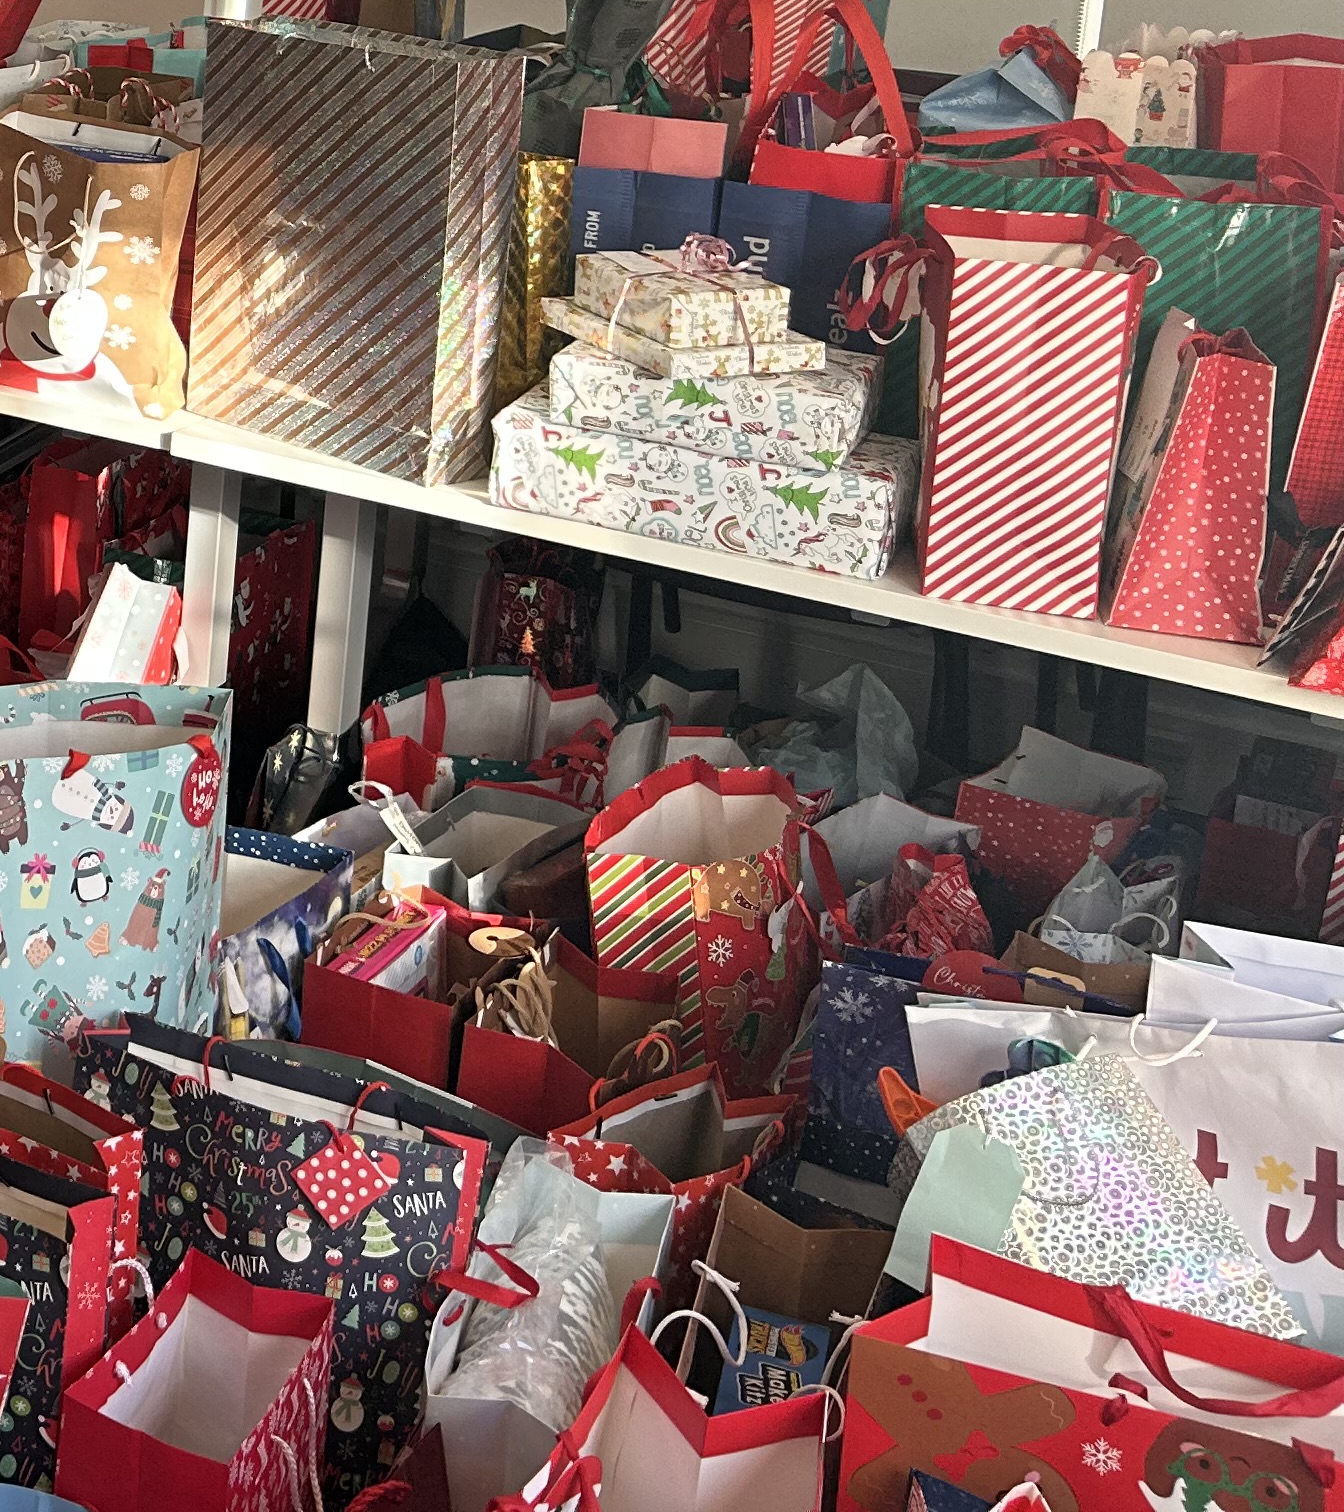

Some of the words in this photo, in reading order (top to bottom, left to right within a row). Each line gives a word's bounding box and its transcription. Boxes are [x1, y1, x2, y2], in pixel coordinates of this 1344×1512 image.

[584, 210, 601, 249] FROM
[392, 1190, 447, 1219] SANTA
[220, 1249, 270, 1280] SANTA
[22, 1280, 55, 1306] NTA
